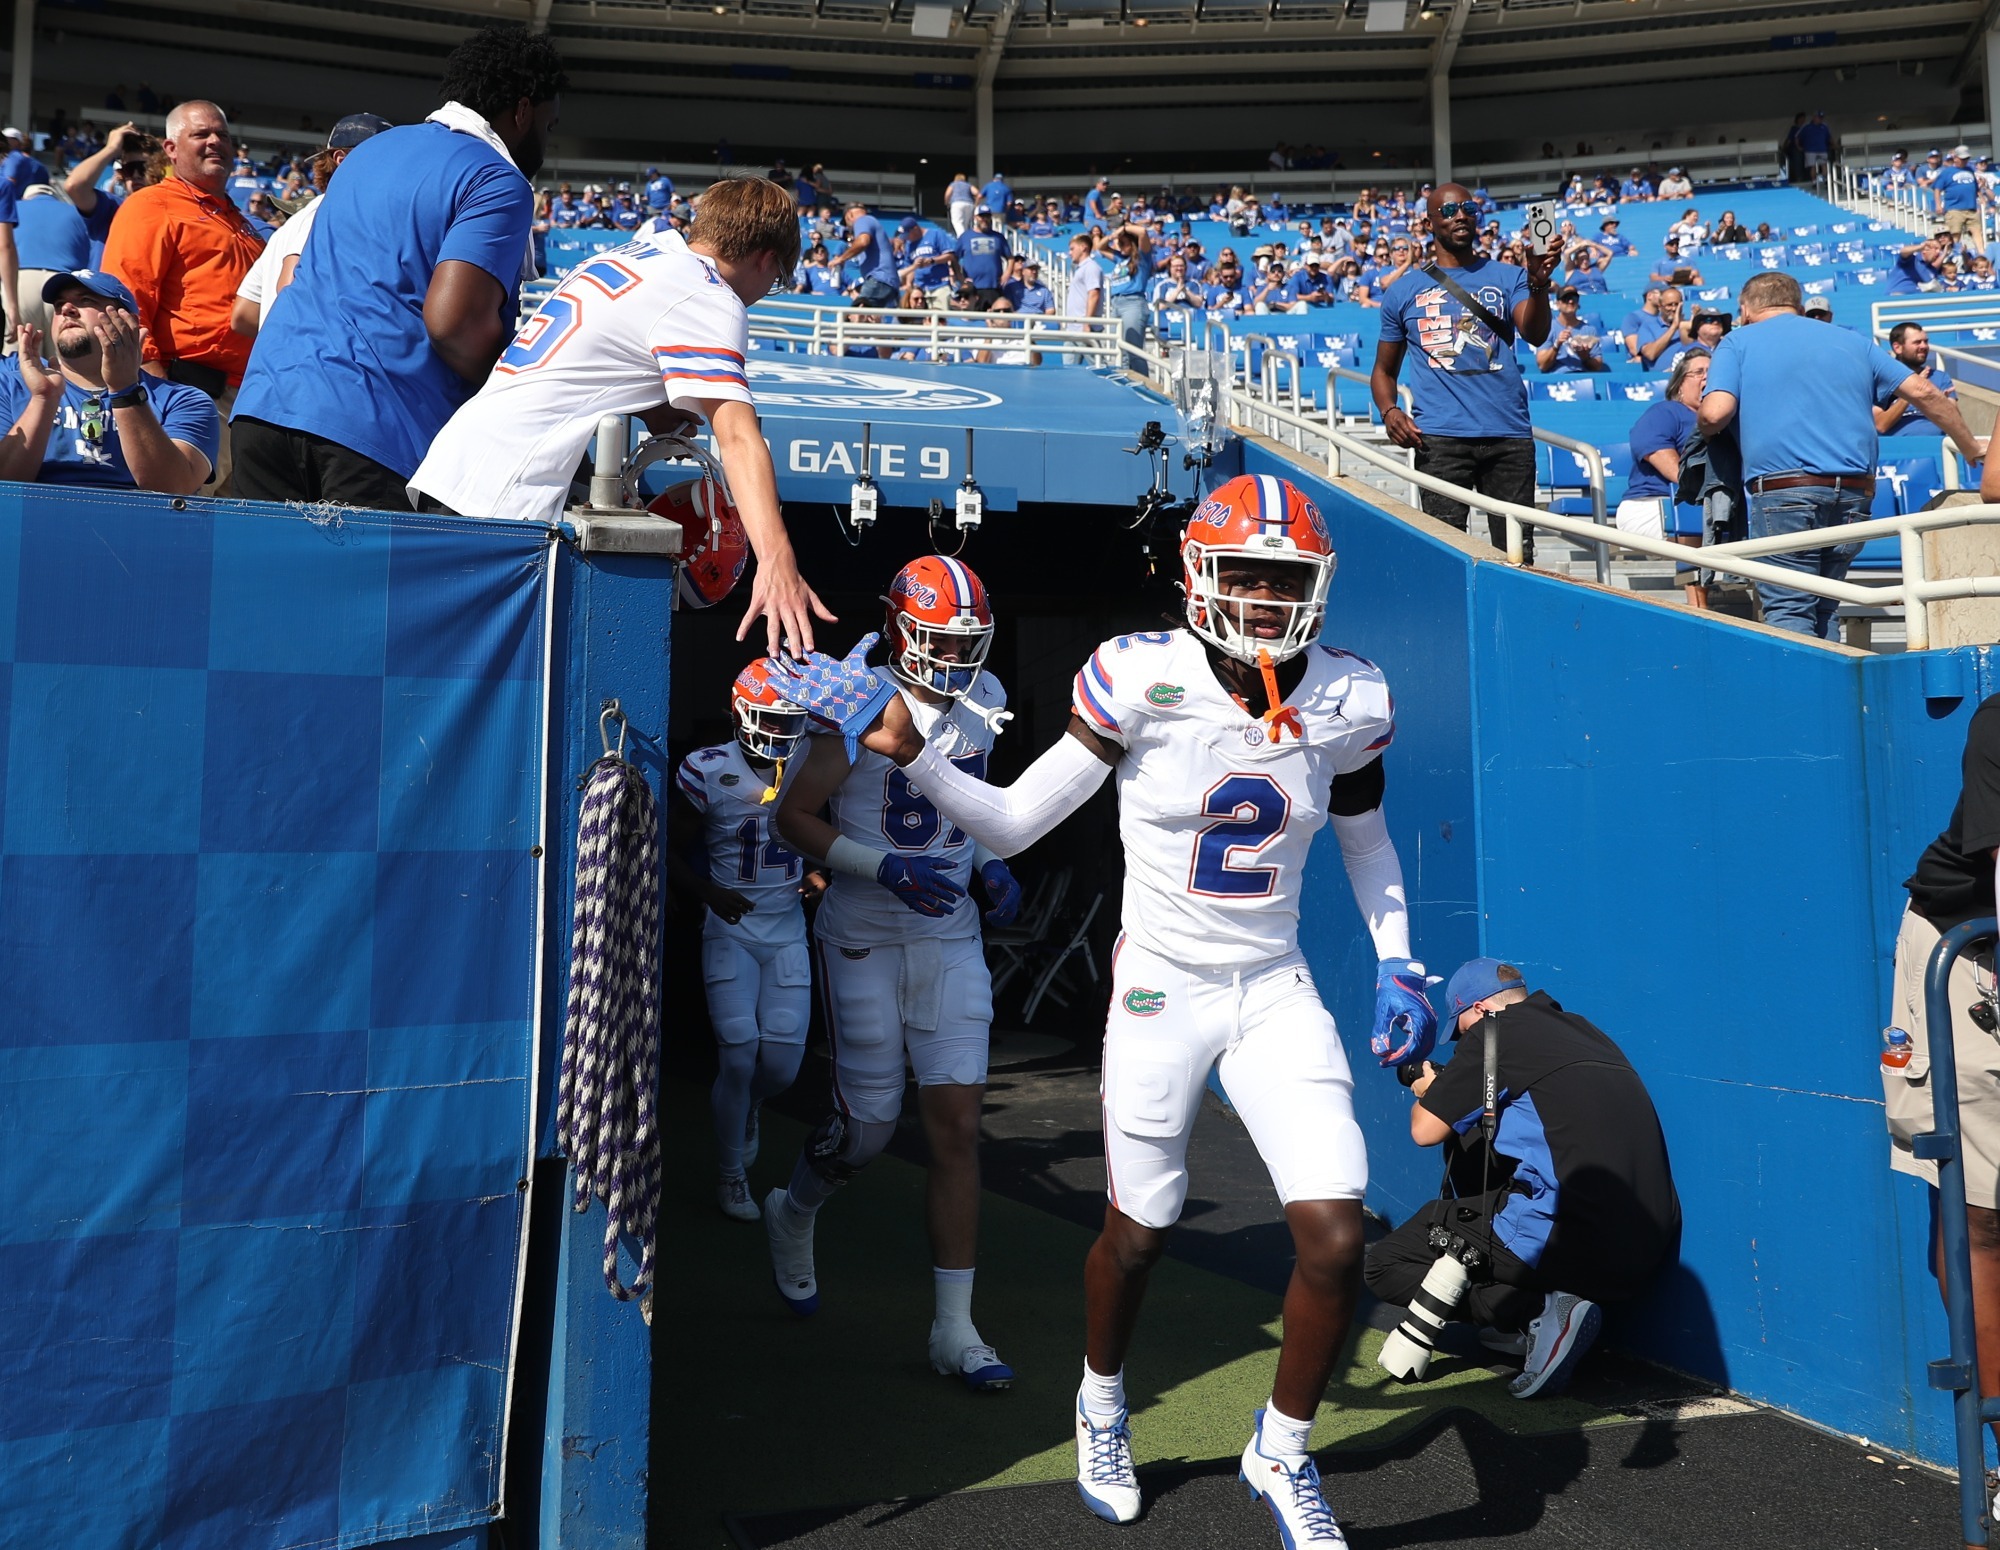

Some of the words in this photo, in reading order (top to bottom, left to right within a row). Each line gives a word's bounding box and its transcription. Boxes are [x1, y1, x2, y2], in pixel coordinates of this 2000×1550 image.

[789, 438, 906, 479] GATE
[920, 447, 951, 480] 9
[881, 749, 987, 850] 87
[736, 816, 800, 882] 14
[1187, 772, 1292, 898] 2
[1486, 1073, 1495, 1110] SONY
